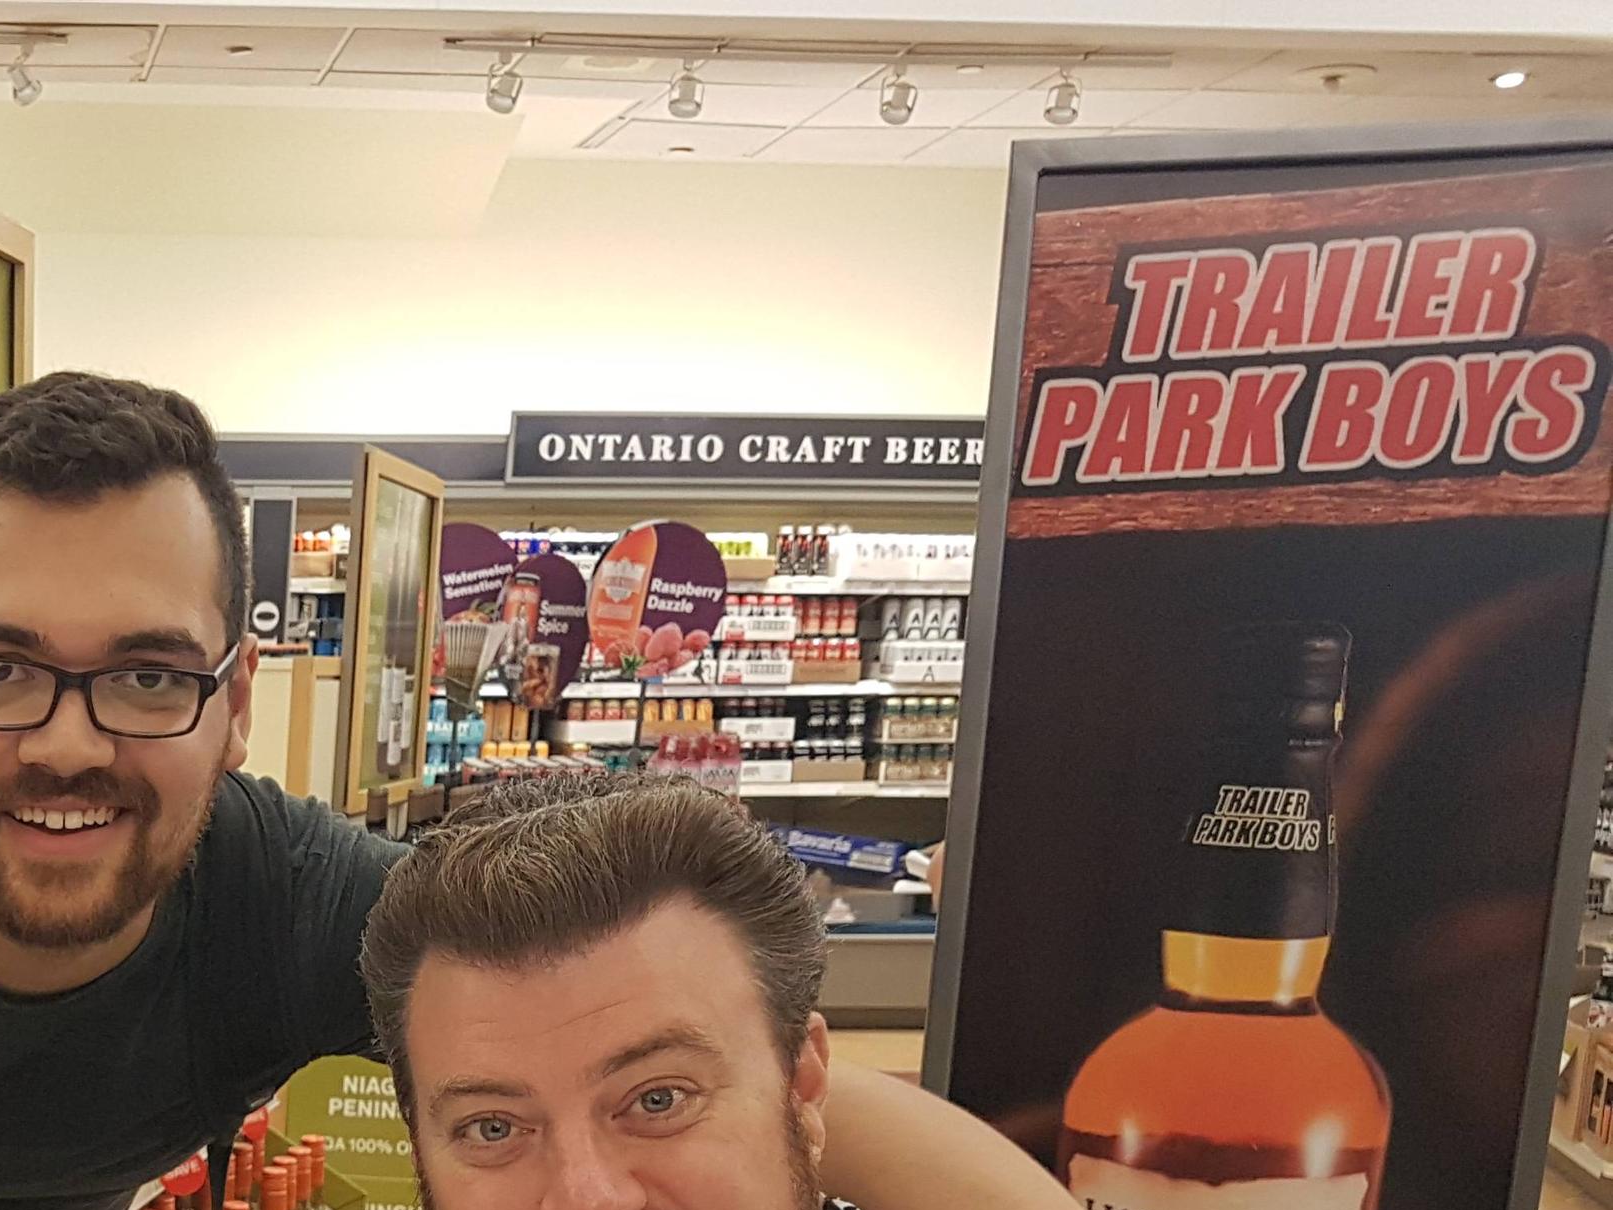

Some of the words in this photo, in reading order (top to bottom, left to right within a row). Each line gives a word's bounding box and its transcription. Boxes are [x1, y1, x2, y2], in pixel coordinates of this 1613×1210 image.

[1121, 228, 1536, 362] TRAILER
[1021, 364, 1307, 486] PARK
[1298, 345, 1596, 471] BOYS
[538, 433, 724, 464] ONTARIO
[738, 434, 872, 464] CRAFT
[884, 437, 984, 465] BEER
[443, 562, 514, 586] Watermelon
[444, 577, 503, 600] Sensation
[650, 577, 724, 603] Raspberry
[539, 601, 586, 618] Summer
[647, 595, 694, 613] Dazzle
[537, 618, 569, 635] Spice
[1215, 784, 1310, 819] TRAILER
[1192, 815, 1259, 849] PARK
[1255, 820, 1320, 851] BOYS
[343, 1075, 397, 1096] NIAG
[328, 1098, 397, 1119] PENIN
[350, 1138, 393, 1155] 100%
